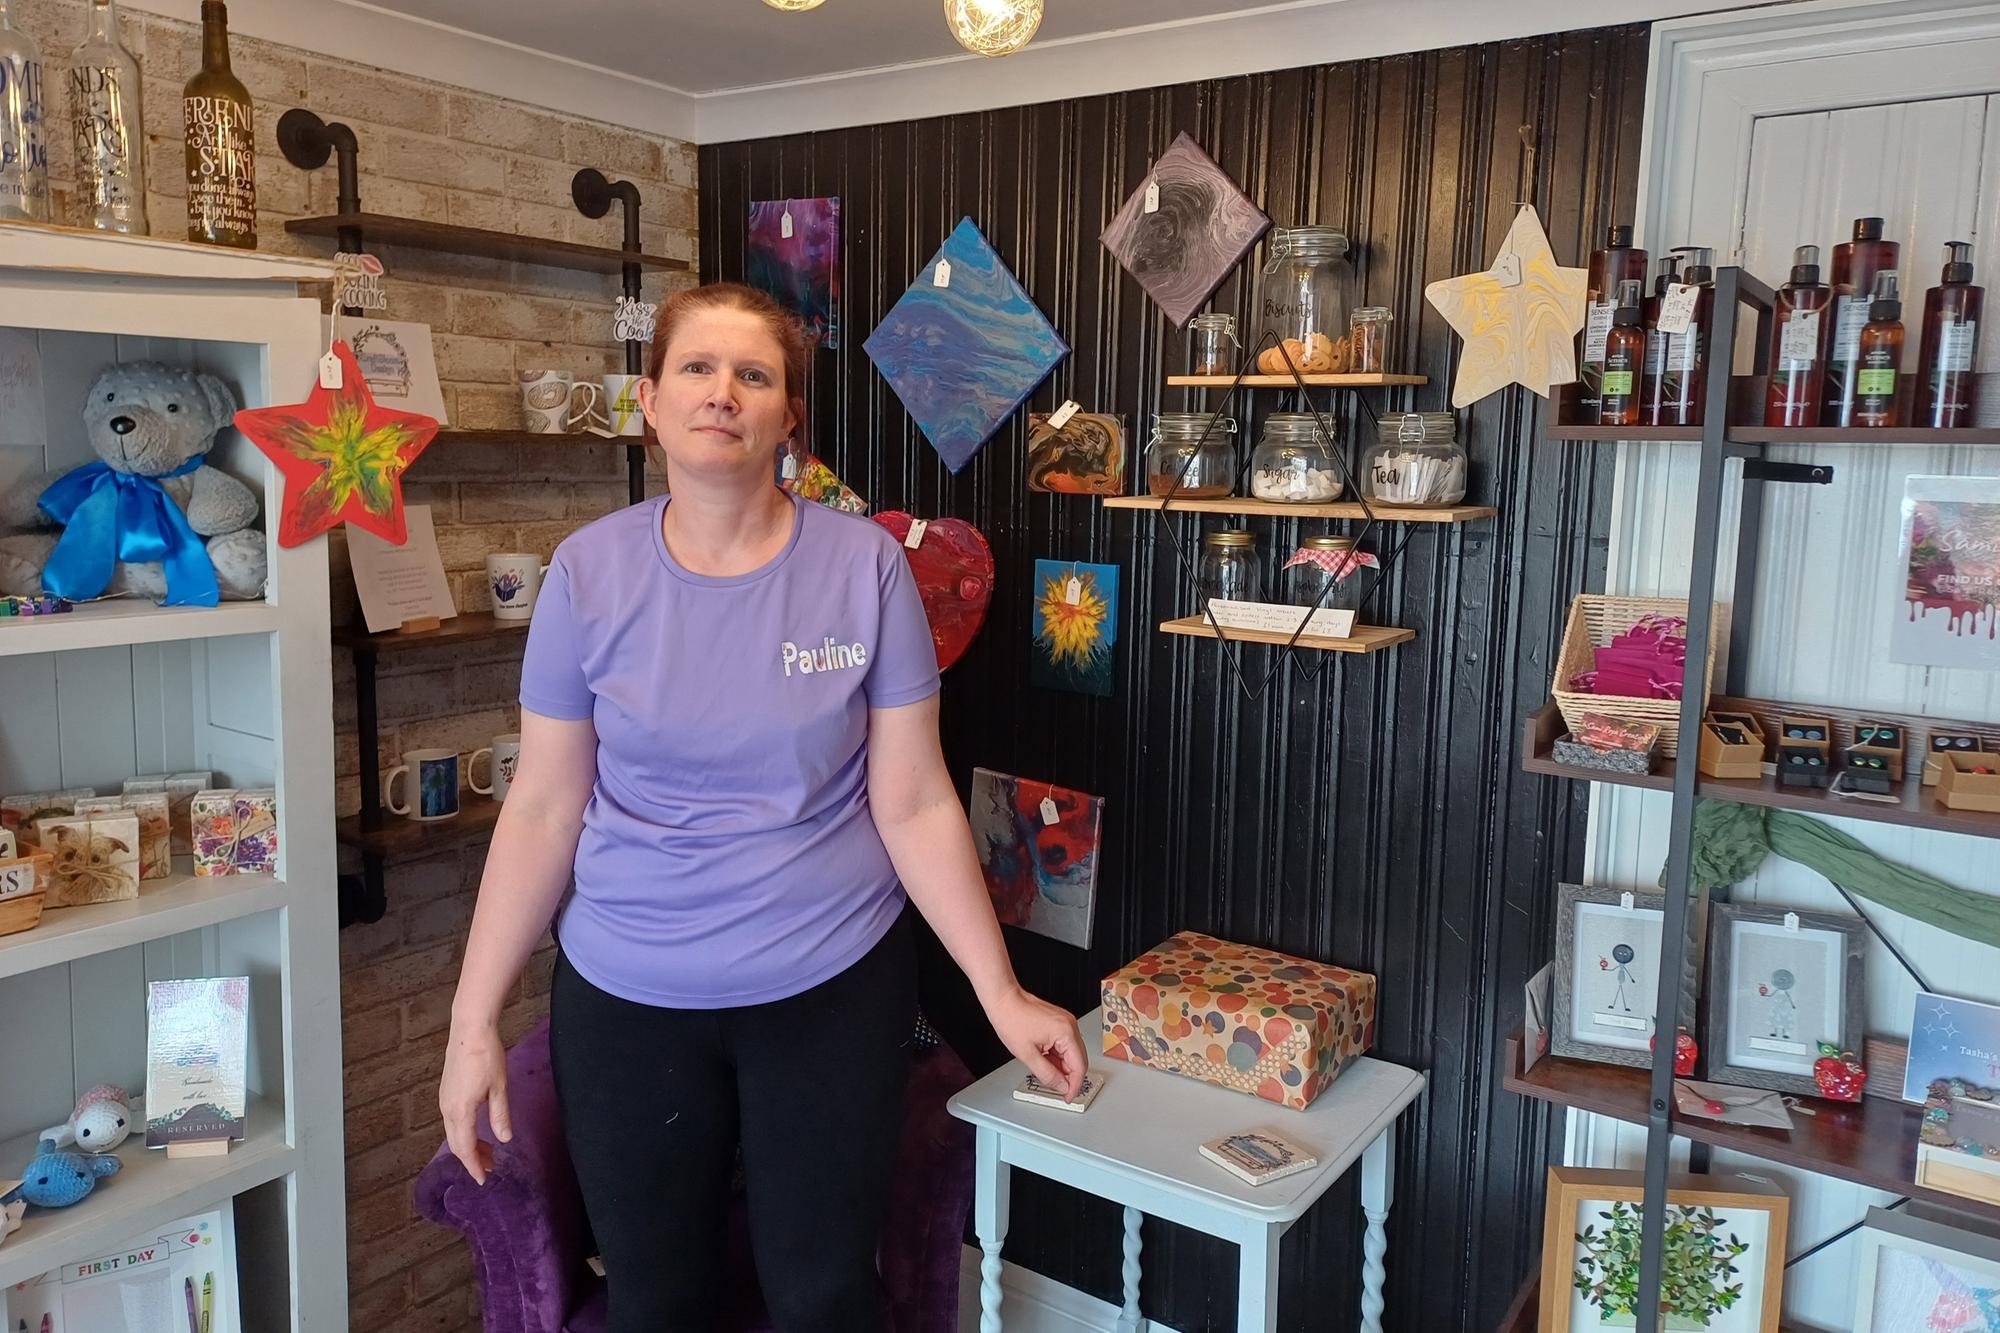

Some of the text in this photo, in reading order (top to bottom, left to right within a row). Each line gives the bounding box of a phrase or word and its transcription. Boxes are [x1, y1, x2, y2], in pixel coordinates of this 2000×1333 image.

[343, 289, 387, 309] COOKING
[616, 297, 655, 318] Kiss
[1265, 299, 1314, 318] Biscuits
[632, 314, 645, 327] the
[1262, 463, 1299, 487] Sugar
[1372, 465, 1401, 485] Tea
[1937, 574, 1993, 586] FIND US
[782, 636, 866, 677] Pauline
[1960, 1046, 1998, 1061] Tasha's
[167, 1122, 226, 1134] RESERVED
[78, 1249, 155, 1277] FIRST DAY
